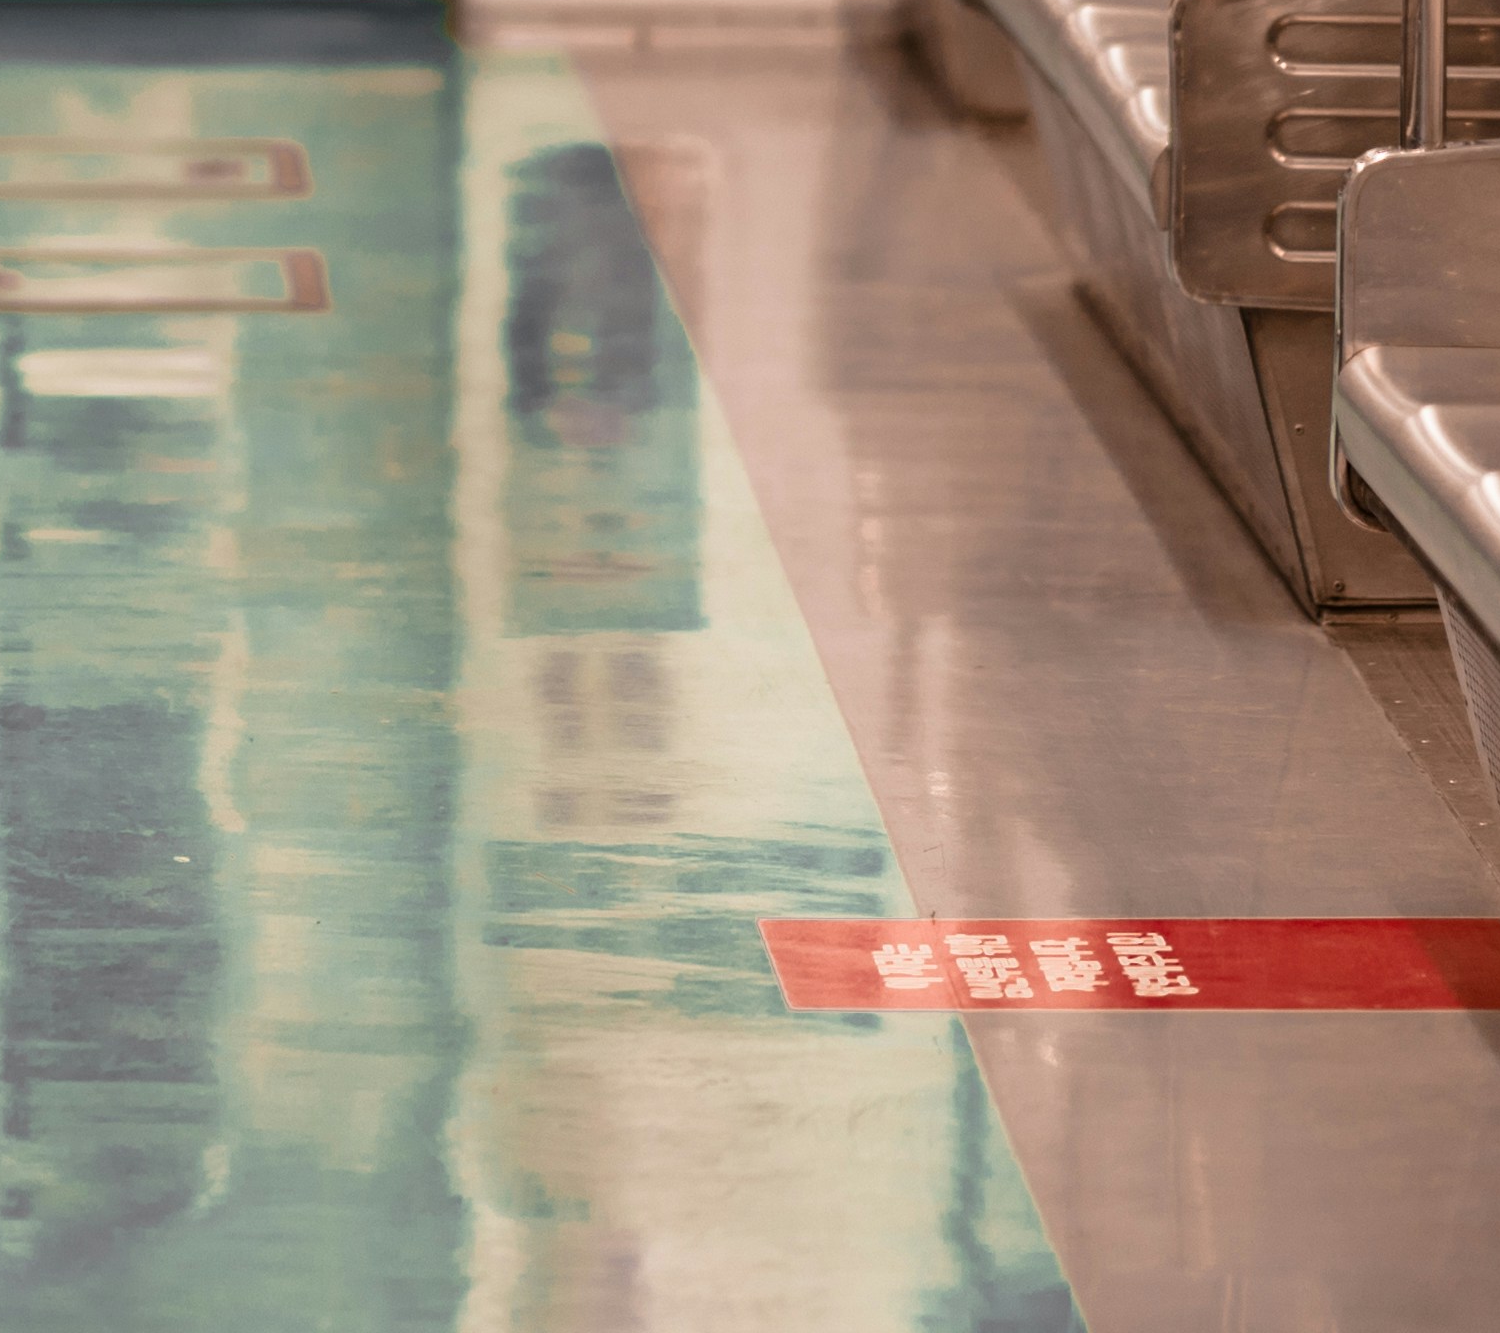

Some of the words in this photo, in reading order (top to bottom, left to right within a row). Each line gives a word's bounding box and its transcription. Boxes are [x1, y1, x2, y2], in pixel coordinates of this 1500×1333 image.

[944, 934, 1012, 956] 위한
[872, 943, 938, 976] 자리는
[884, 976, 944, 990] 이
[956, 957, 1034, 999] 임산부를
